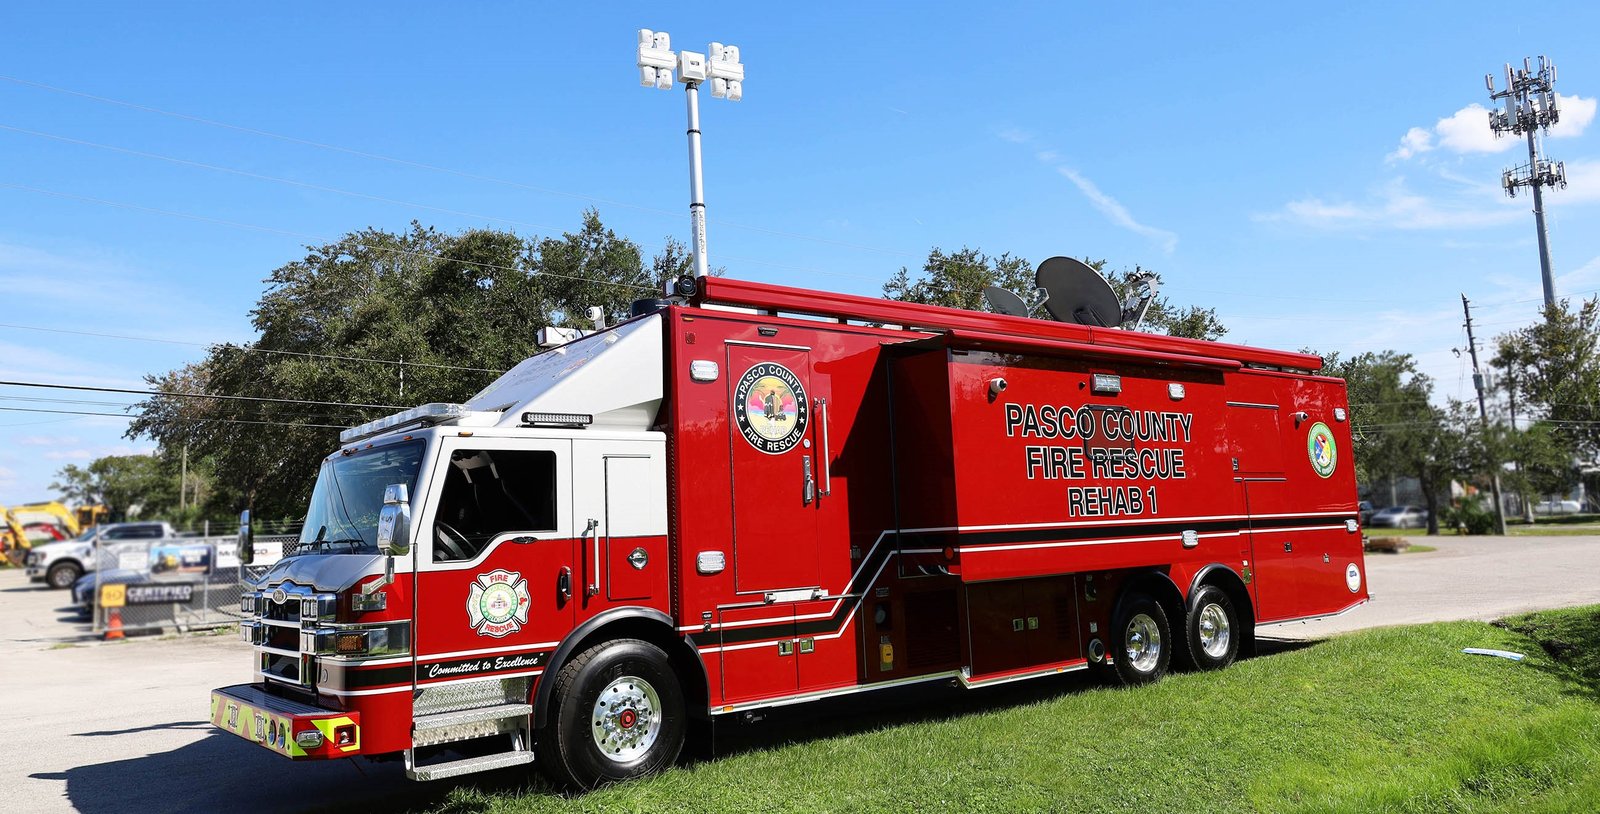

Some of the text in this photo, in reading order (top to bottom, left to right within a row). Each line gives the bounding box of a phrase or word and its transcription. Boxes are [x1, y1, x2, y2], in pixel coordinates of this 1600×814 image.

[739, 365, 802, 394] PASCO COUNTY
[1005, 402, 1192, 443] PASCO COUNTY
[744, 427, 801, 451] FIRE RESCUE
[1025, 445, 1186, 480] FIRE RESCUE
[1067, 486, 1157, 518] REHAB 1
[489, 574, 509, 583] FIRE
[127, 585, 192, 598] CERTIFIED
[485, 621, 514, 633] RESCUE
[482, 661, 491, 671] to
